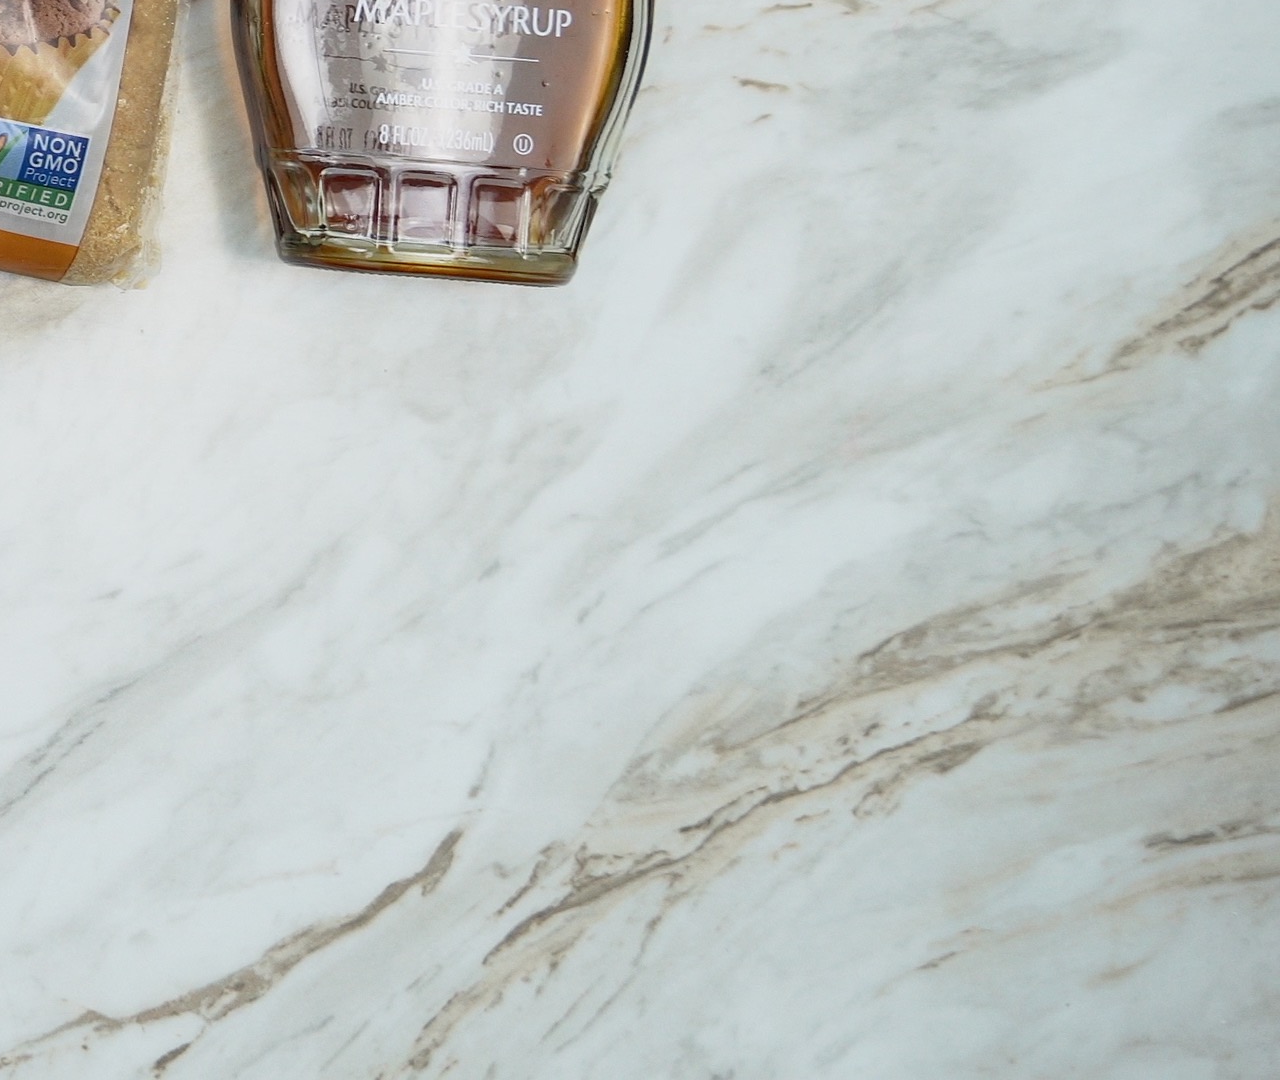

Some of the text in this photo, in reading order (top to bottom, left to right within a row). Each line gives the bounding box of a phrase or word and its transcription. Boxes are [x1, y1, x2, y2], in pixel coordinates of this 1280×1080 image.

[477, 3, 572, 38] SYRUP
[494, 84, 504, 95] A
[376, 93, 422, 107] AMBER
[475, 101, 504, 113] RICH
[506, 103, 543, 117] TASTE
[33, 134, 82, 157] NON
[380, 124, 389, 144] 8
[442, 129, 494, 154] (236mL)
[29, 152, 80, 174] GMO
[24, 168, 76, 188] Project
